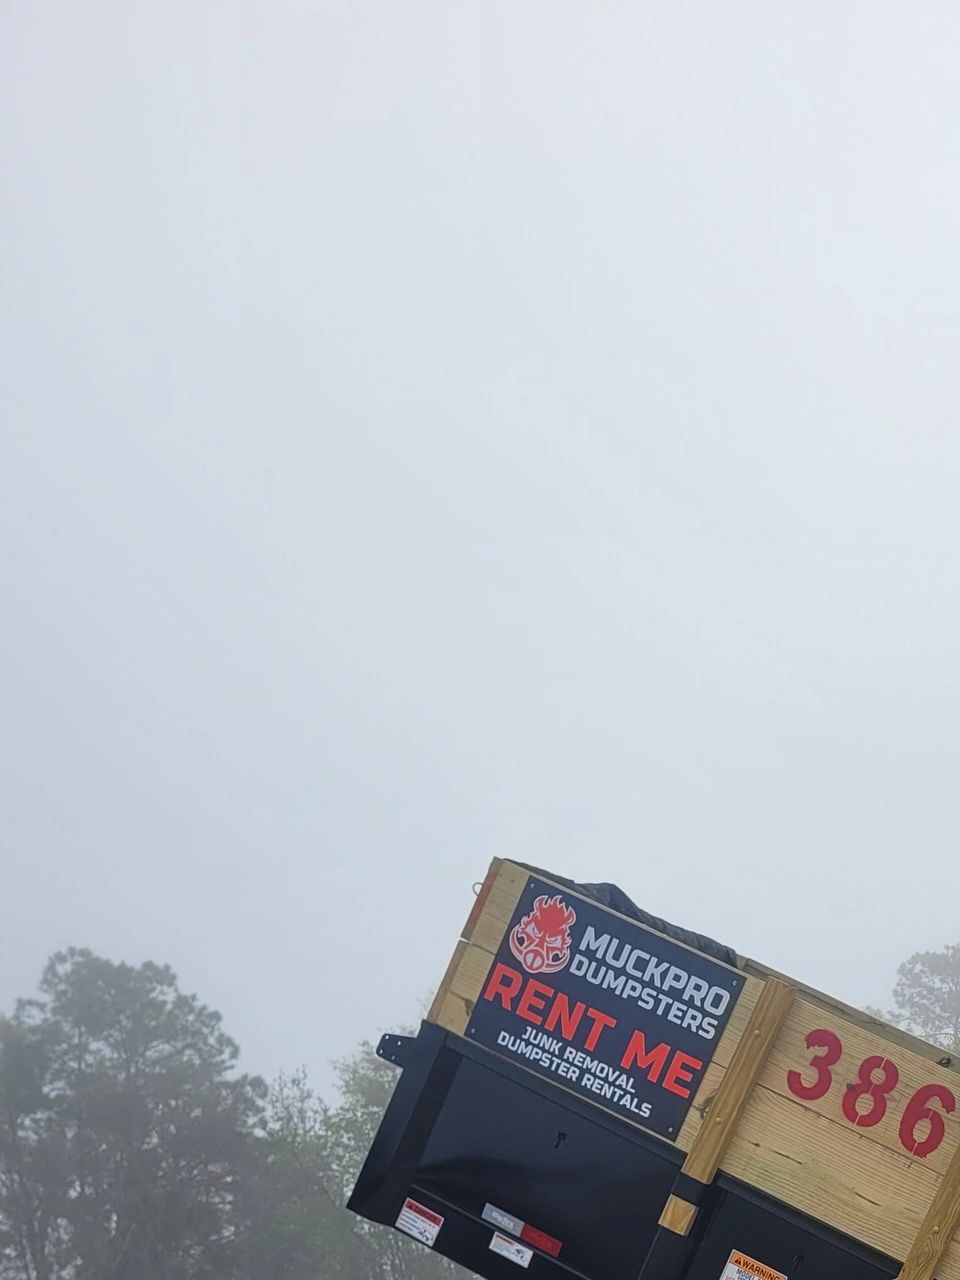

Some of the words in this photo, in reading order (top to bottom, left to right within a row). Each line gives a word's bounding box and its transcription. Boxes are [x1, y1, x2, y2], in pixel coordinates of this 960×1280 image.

[569, 954, 718, 1039] DUMPSTERS
[579, 926, 730, 1015] MUCKPRO
[484, 963, 617, 1051] RENT
[620, 1030, 703, 1098] ME
[497, 1031, 579, 1081] DUMPSTER
[581, 1074, 652, 1118] RENTALS
[522, 1027, 562, 1055] JUNK
[564, 1047, 635, 1093] REMOVAL
[785, 1028, 956, 1159] 386
